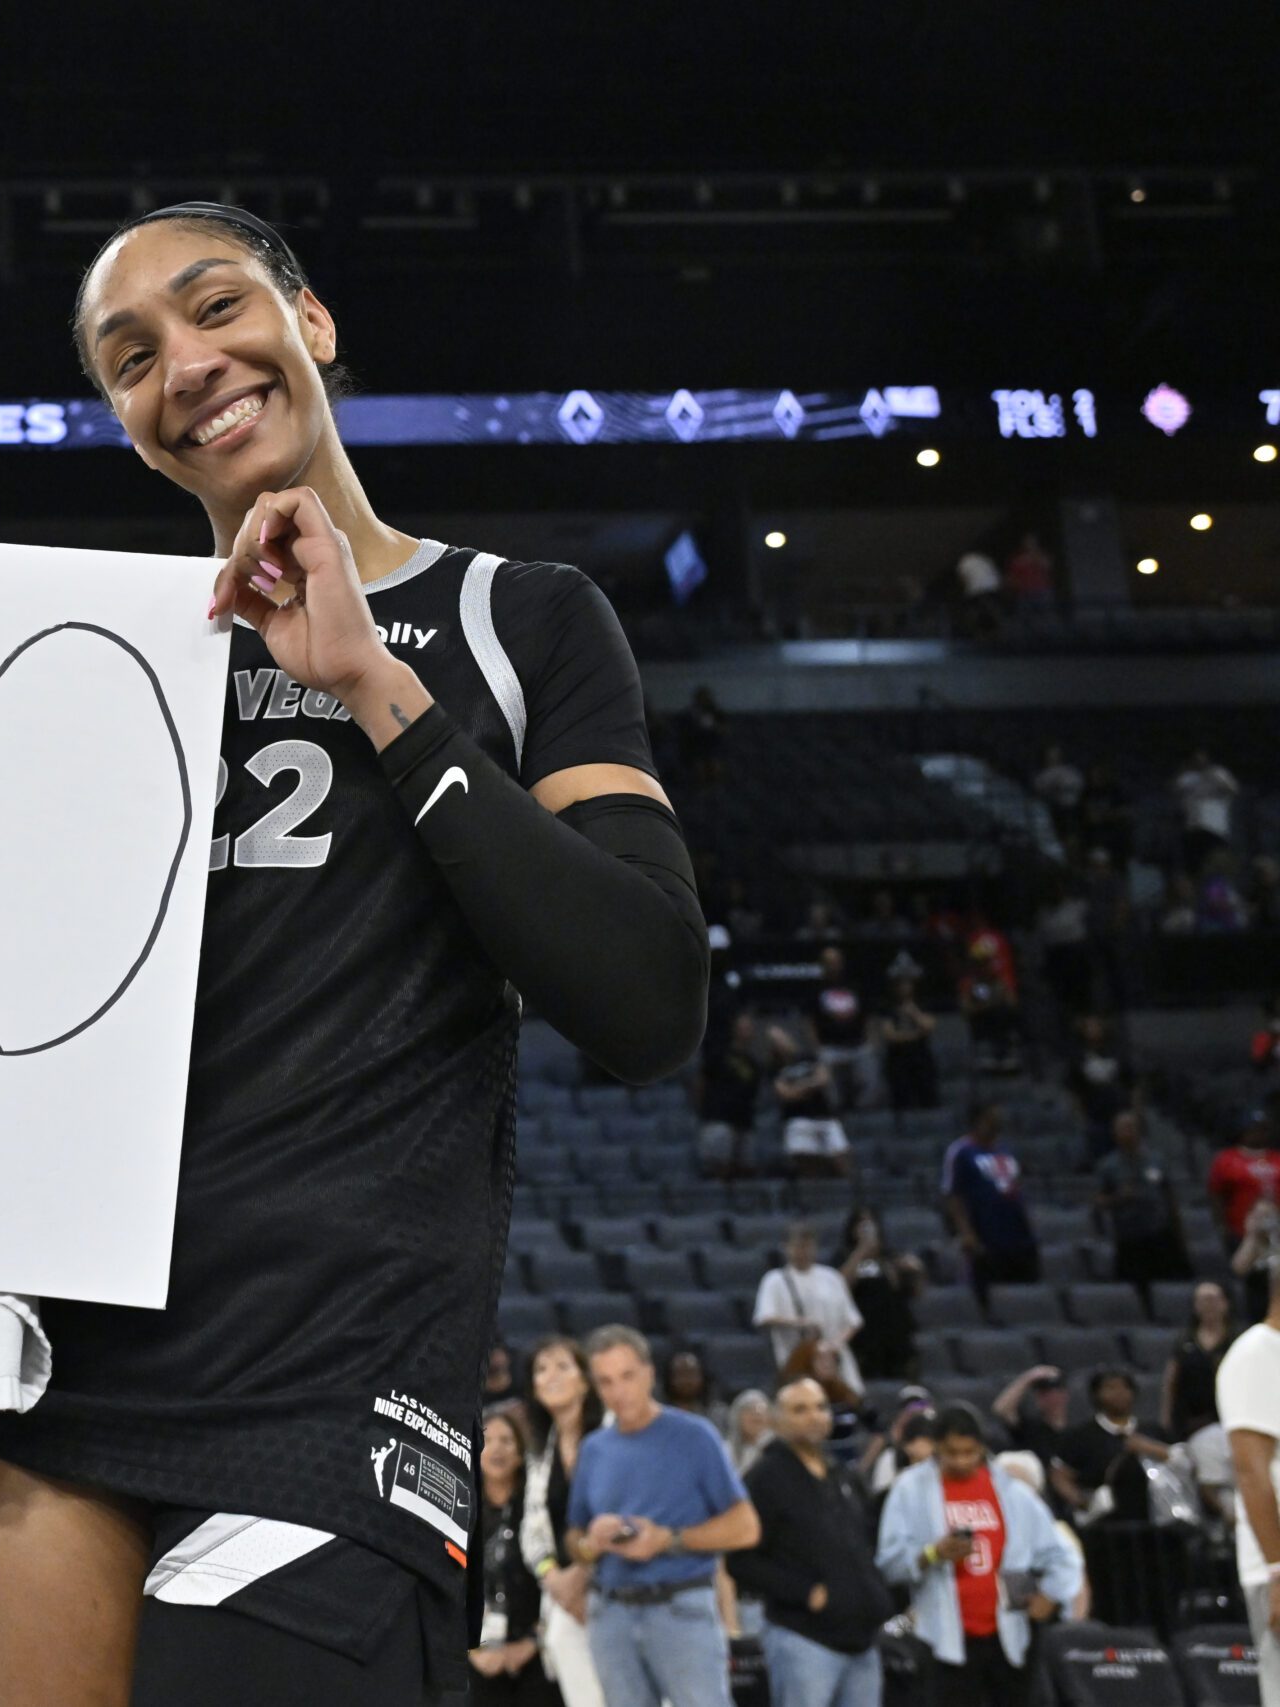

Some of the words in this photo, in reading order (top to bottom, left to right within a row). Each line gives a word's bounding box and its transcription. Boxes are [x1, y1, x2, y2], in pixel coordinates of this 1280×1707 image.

[208, 739, 333, 872] 2
[373, 1396, 405, 1421] NIKE
[404, 1409, 449, 1450] EXPLORER
[390, 1389, 418, 1409] LAS
[419, 1403, 449, 1432] VEGAS
[450, 1427, 472, 1450] ACES
[403, 1462, 416, 1476] 46
